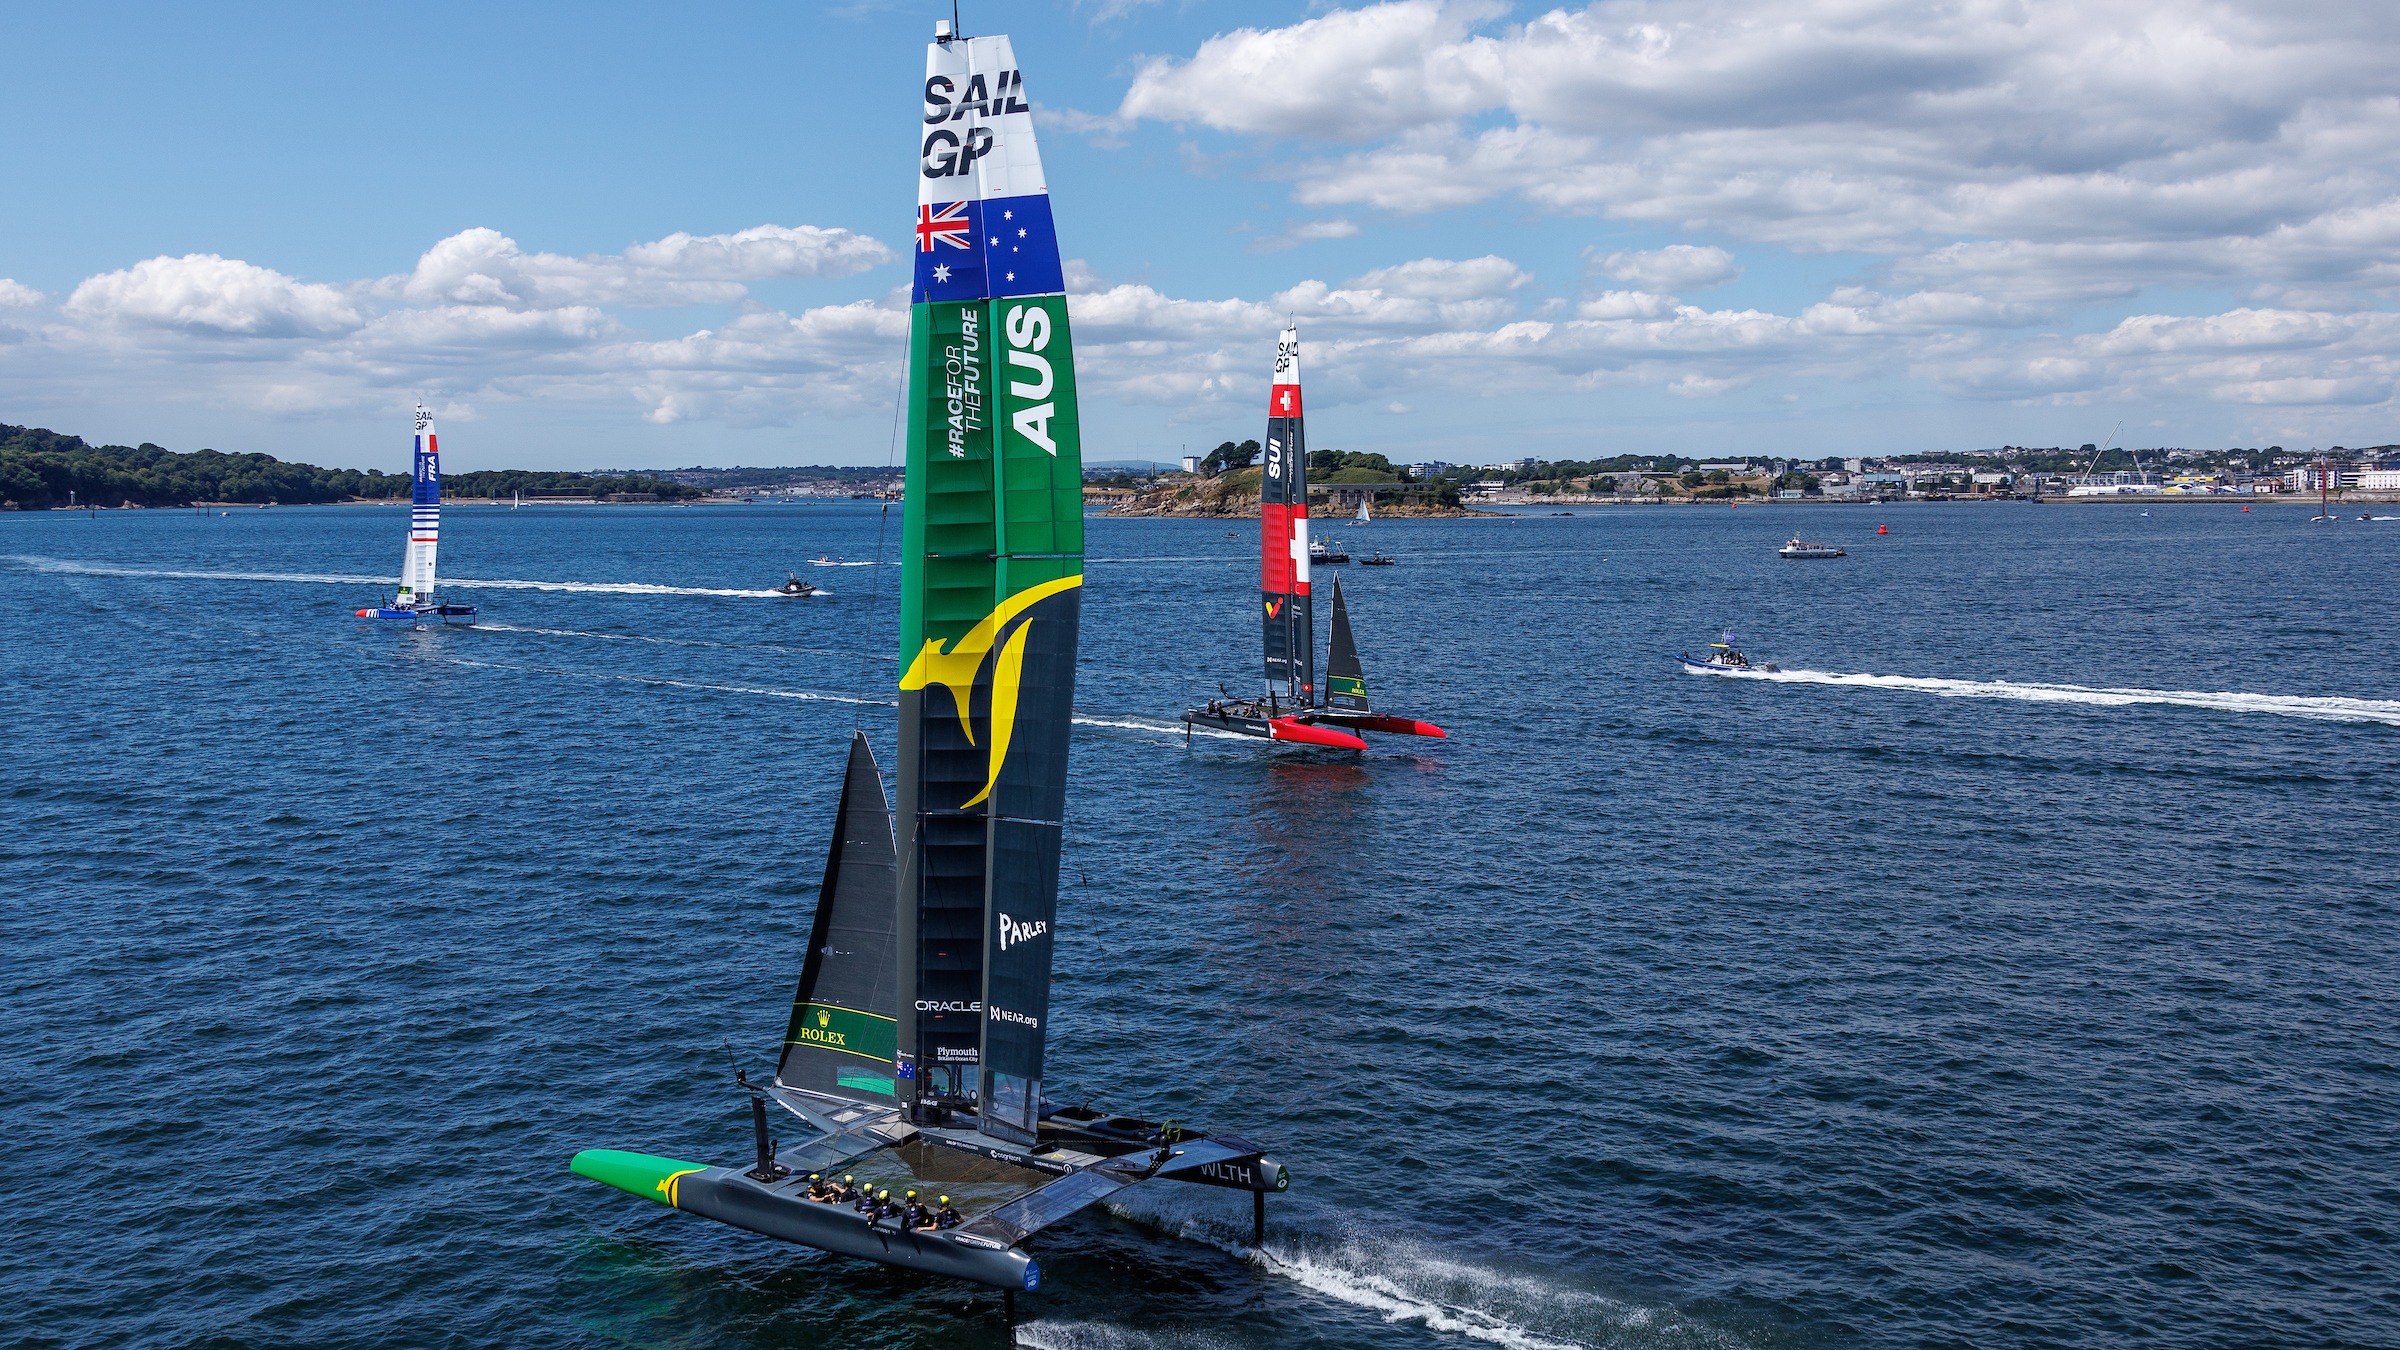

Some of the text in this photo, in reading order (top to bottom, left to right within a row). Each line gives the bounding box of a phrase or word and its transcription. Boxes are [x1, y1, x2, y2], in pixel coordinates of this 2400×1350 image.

[923, 69, 1030, 125] SAIL
[921, 126, 995, 179] GP
[1277, 341, 1298, 357] SAIL
[961, 307, 982, 433] THEFUTURE
[1275, 357, 1290, 373] GP
[1005, 304, 1057, 457] AUS
[945, 345, 965, 459] #RACEFOR
[415, 421, 428, 431] GP
[427, 455, 437, 482] FRA
[1268, 437, 1281, 480] SUI
[999, 912, 1047, 951] PARLEY
[914, 1000, 983, 1012] ORACLE
[1001, 1011, 1038, 1028] NEAR.org
[800, 1026, 846, 1046] ROLEX
[936, 1046, 978, 1057] Plymouth
[1200, 1162, 1252, 1184] WLTH
